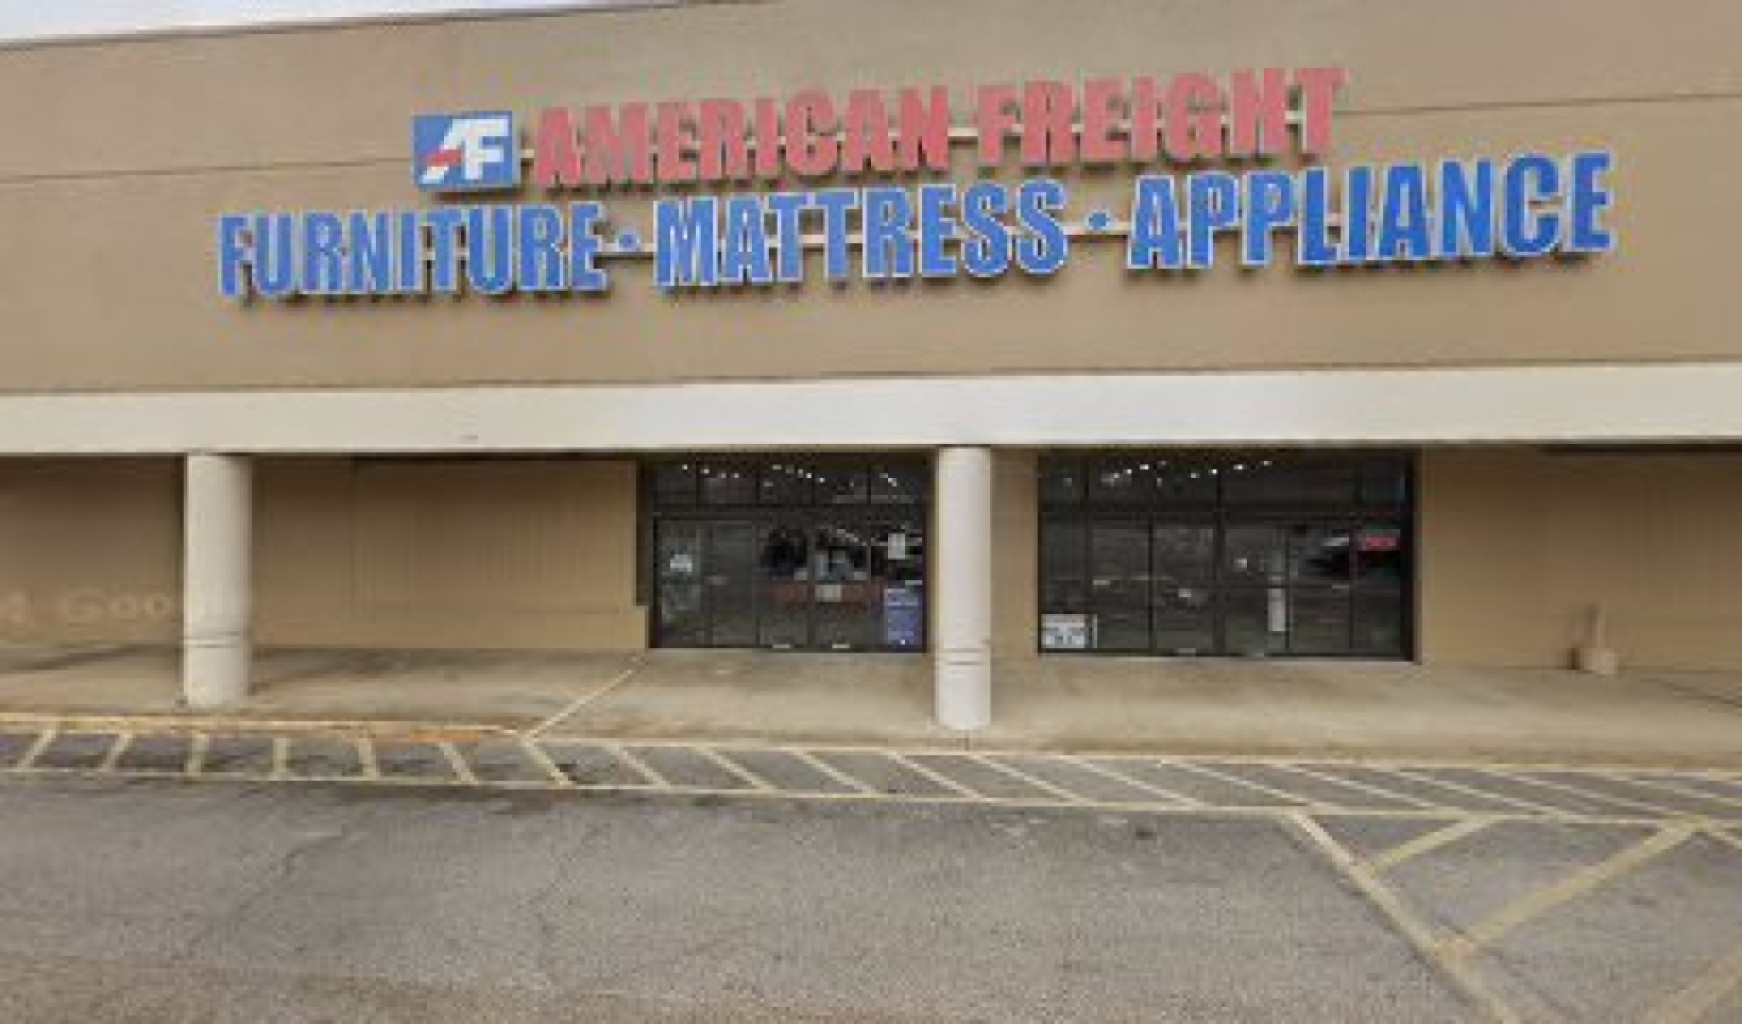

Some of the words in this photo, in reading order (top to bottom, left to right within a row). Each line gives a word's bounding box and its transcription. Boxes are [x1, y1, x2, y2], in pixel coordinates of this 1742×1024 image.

[421, 117, 509, 184] AF
[534, 86, 950, 185] AMERICAN
[977, 67, 1345, 167] FREIGHT
[217, 202, 607, 296] FURNITURE
[654, 180, 1069, 288] MATTRESS
[1127, 151, 1614, 271] APPLIANCE
